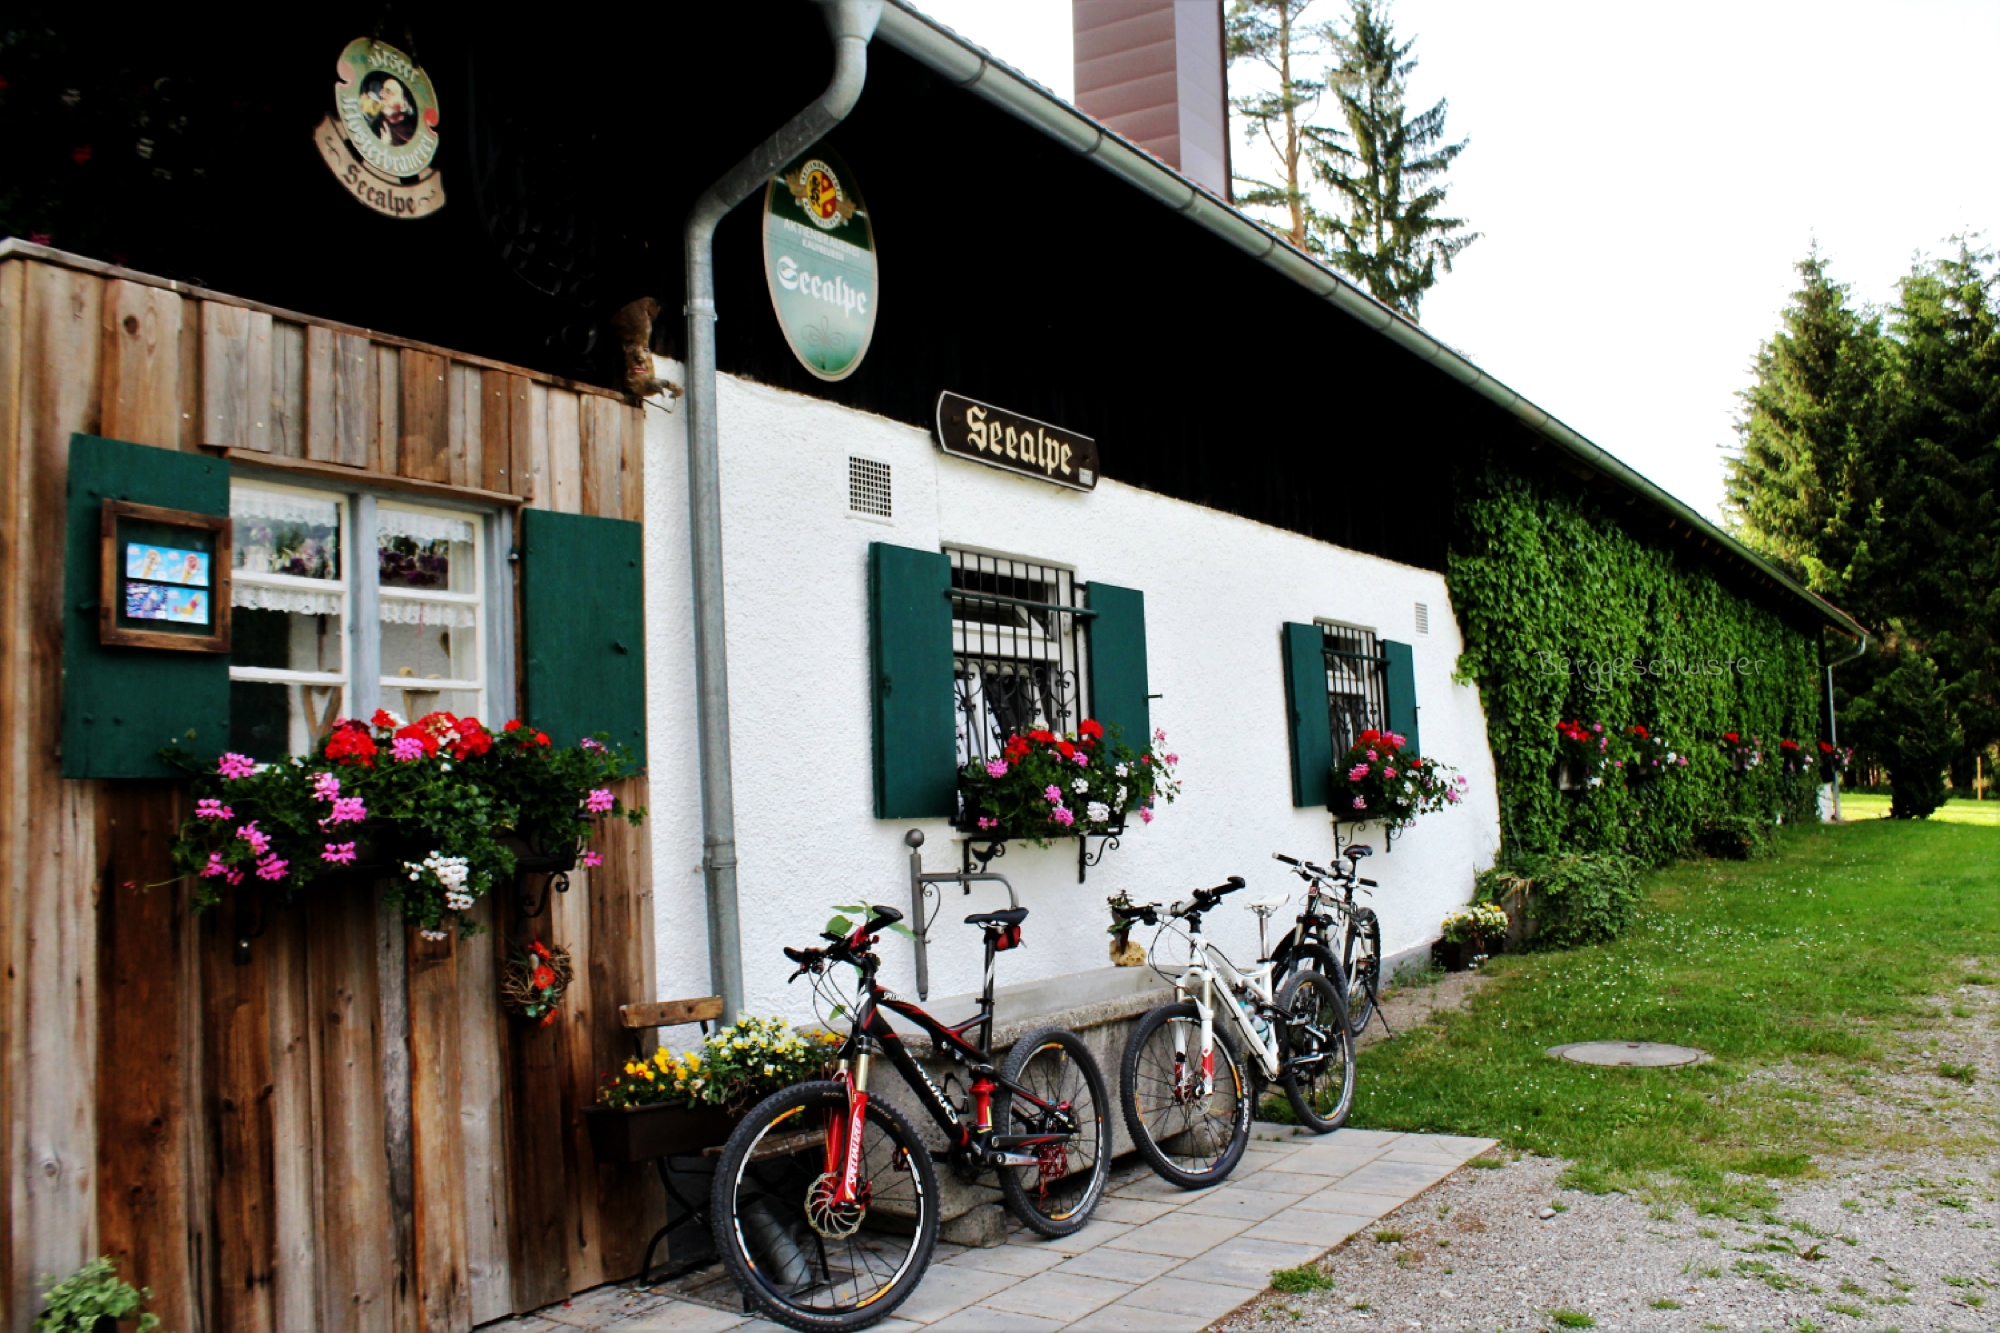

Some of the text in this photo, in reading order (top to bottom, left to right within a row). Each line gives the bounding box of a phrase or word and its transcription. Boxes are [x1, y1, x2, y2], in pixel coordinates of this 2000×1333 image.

[342, 164, 416, 216] Seealpe
[777, 255, 867, 318] Seealpe
[966, 405, 1072, 475] Seealpe
[847, 1117, 862, 1184] SPECIALIZED
